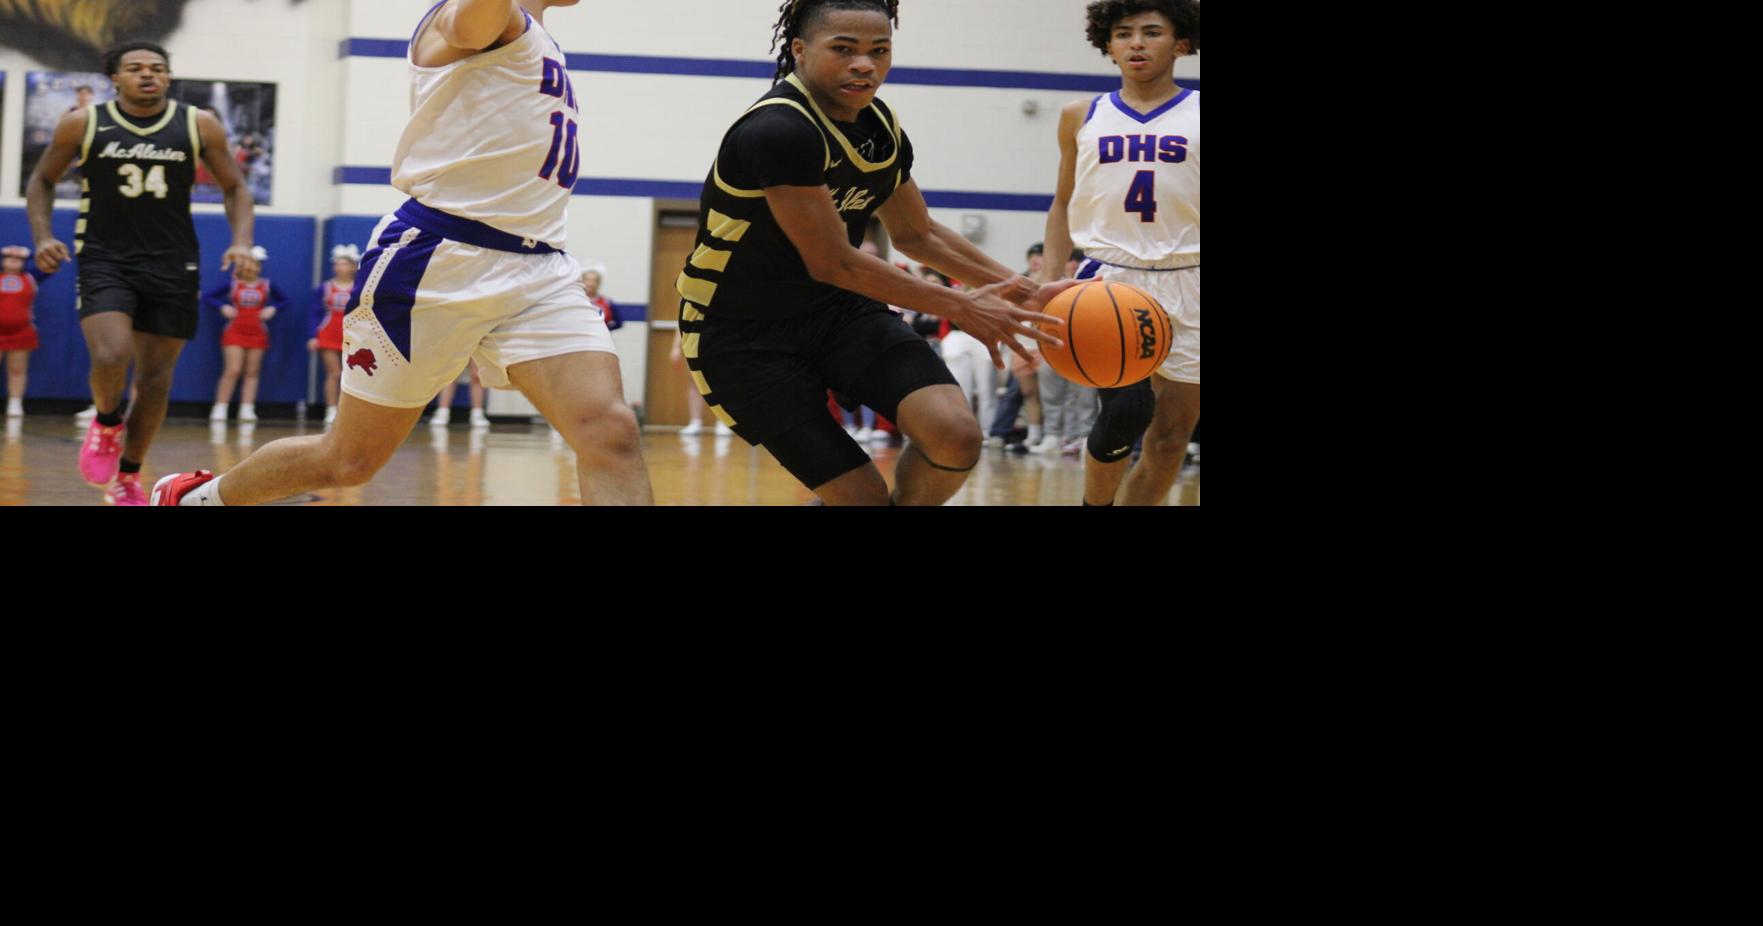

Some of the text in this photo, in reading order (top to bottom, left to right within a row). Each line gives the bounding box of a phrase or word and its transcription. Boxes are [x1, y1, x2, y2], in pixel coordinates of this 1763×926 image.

[98, 141, 187, 162] McAlester
[538, 110, 580, 190] 10
[1098, 134, 1188, 164] DHS
[117, 163, 168, 198] 34
[1124, 170, 1157, 223] 4
[1133, 308, 1156, 359] NCAA
